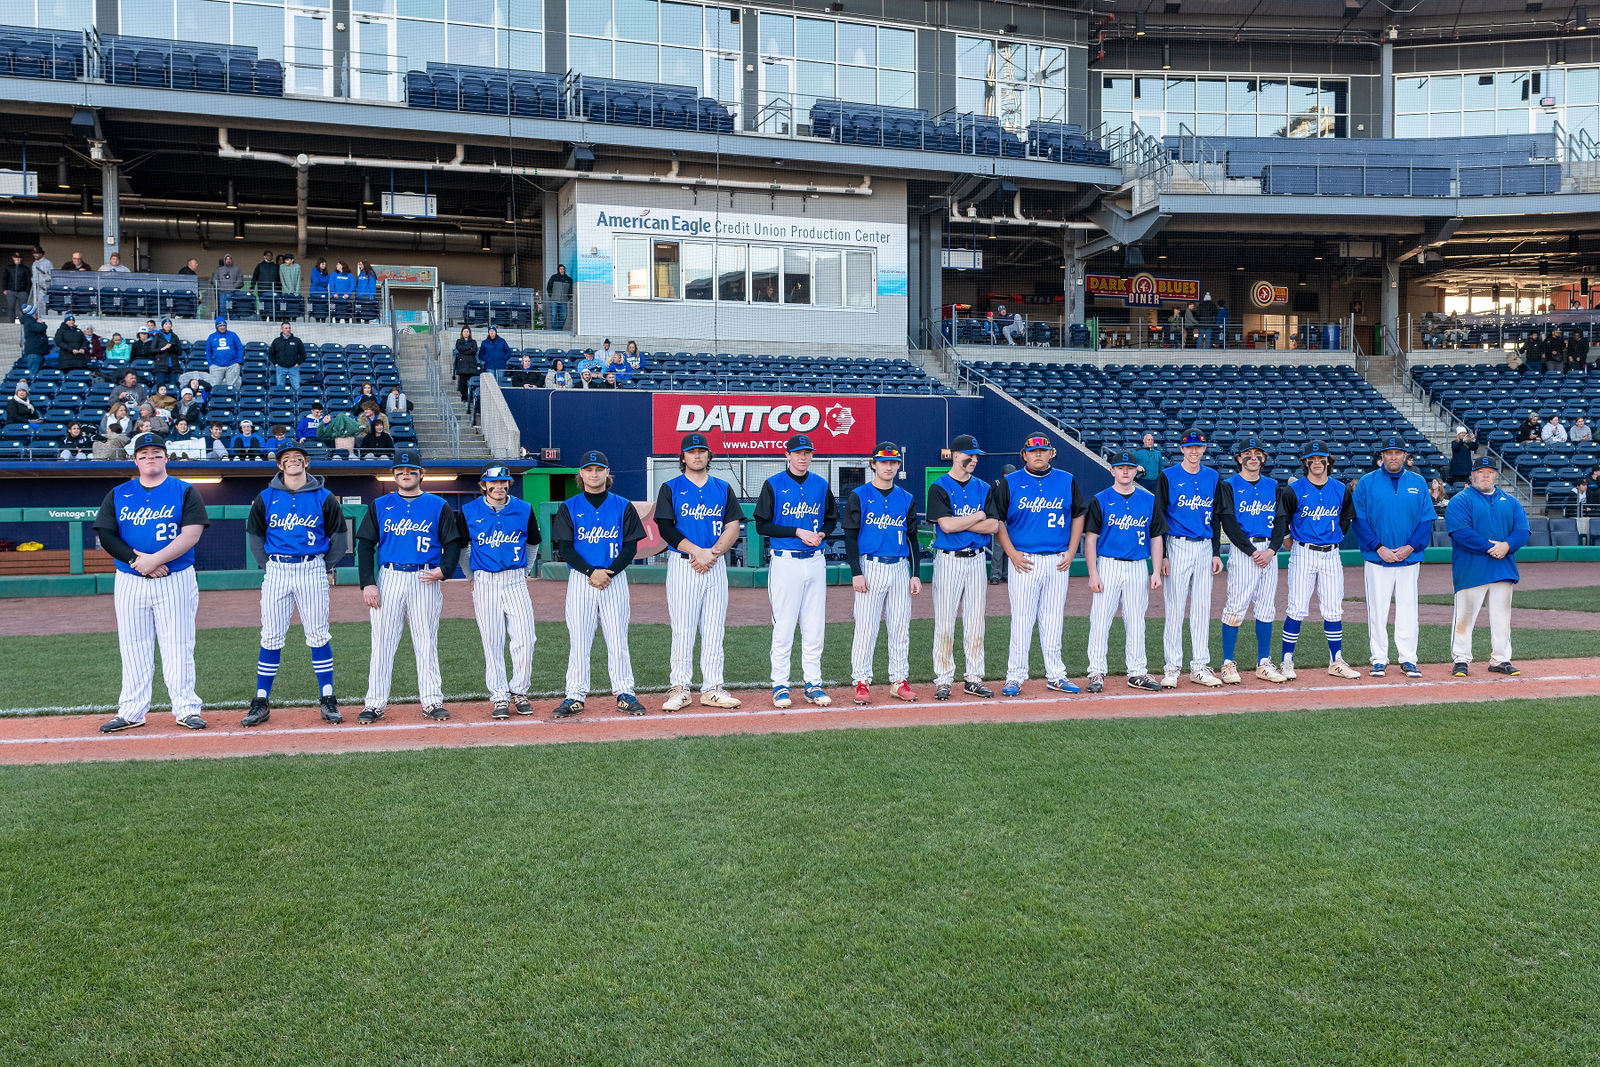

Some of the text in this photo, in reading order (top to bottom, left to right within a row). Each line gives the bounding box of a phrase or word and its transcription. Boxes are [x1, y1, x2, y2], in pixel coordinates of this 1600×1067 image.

[596, 211, 890, 243] American Eagle Credit Union Production Center
[1090, 277, 1196, 294] DARK BLUES
[1128, 293, 1160, 305] DINER
[675, 404, 821, 433] DATTCO
[692, 435, 700, 445] S
[723, 440, 788, 449] www.DATTC
[798, 436, 807, 445] S
[1249, 438, 1256, 446] S
[1312, 443, 1319, 451] S
[1389, 438, 1396, 446] S
[401, 453, 409, 463] S
[590, 453, 597, 462] S
[1122, 453, 1129, 461] S
[1482, 457, 1489, 465] S
[680, 503, 724, 520] Suffield
[781, 501, 821, 519] Suffield
[1018, 496, 1064, 513] Suffield
[1301, 505, 1340, 520] Suffield
[48, 510, 85, 519] Vantage
[119, 505, 176, 526] Suffield
[269, 512, 319, 531] Suffield
[865, 511, 907, 529] Suffield
[1047, 513, 1065, 529] 24
[1107, 513, 1149, 530] Suffield
[155, 522, 178, 542] 23
[384, 518, 433, 536] Suffield
[307, 531, 316, 546] 9
[416, 535, 432, 553] 15
[477, 529, 522, 548] Suffield
[1136, 530, 1146, 546] 12
